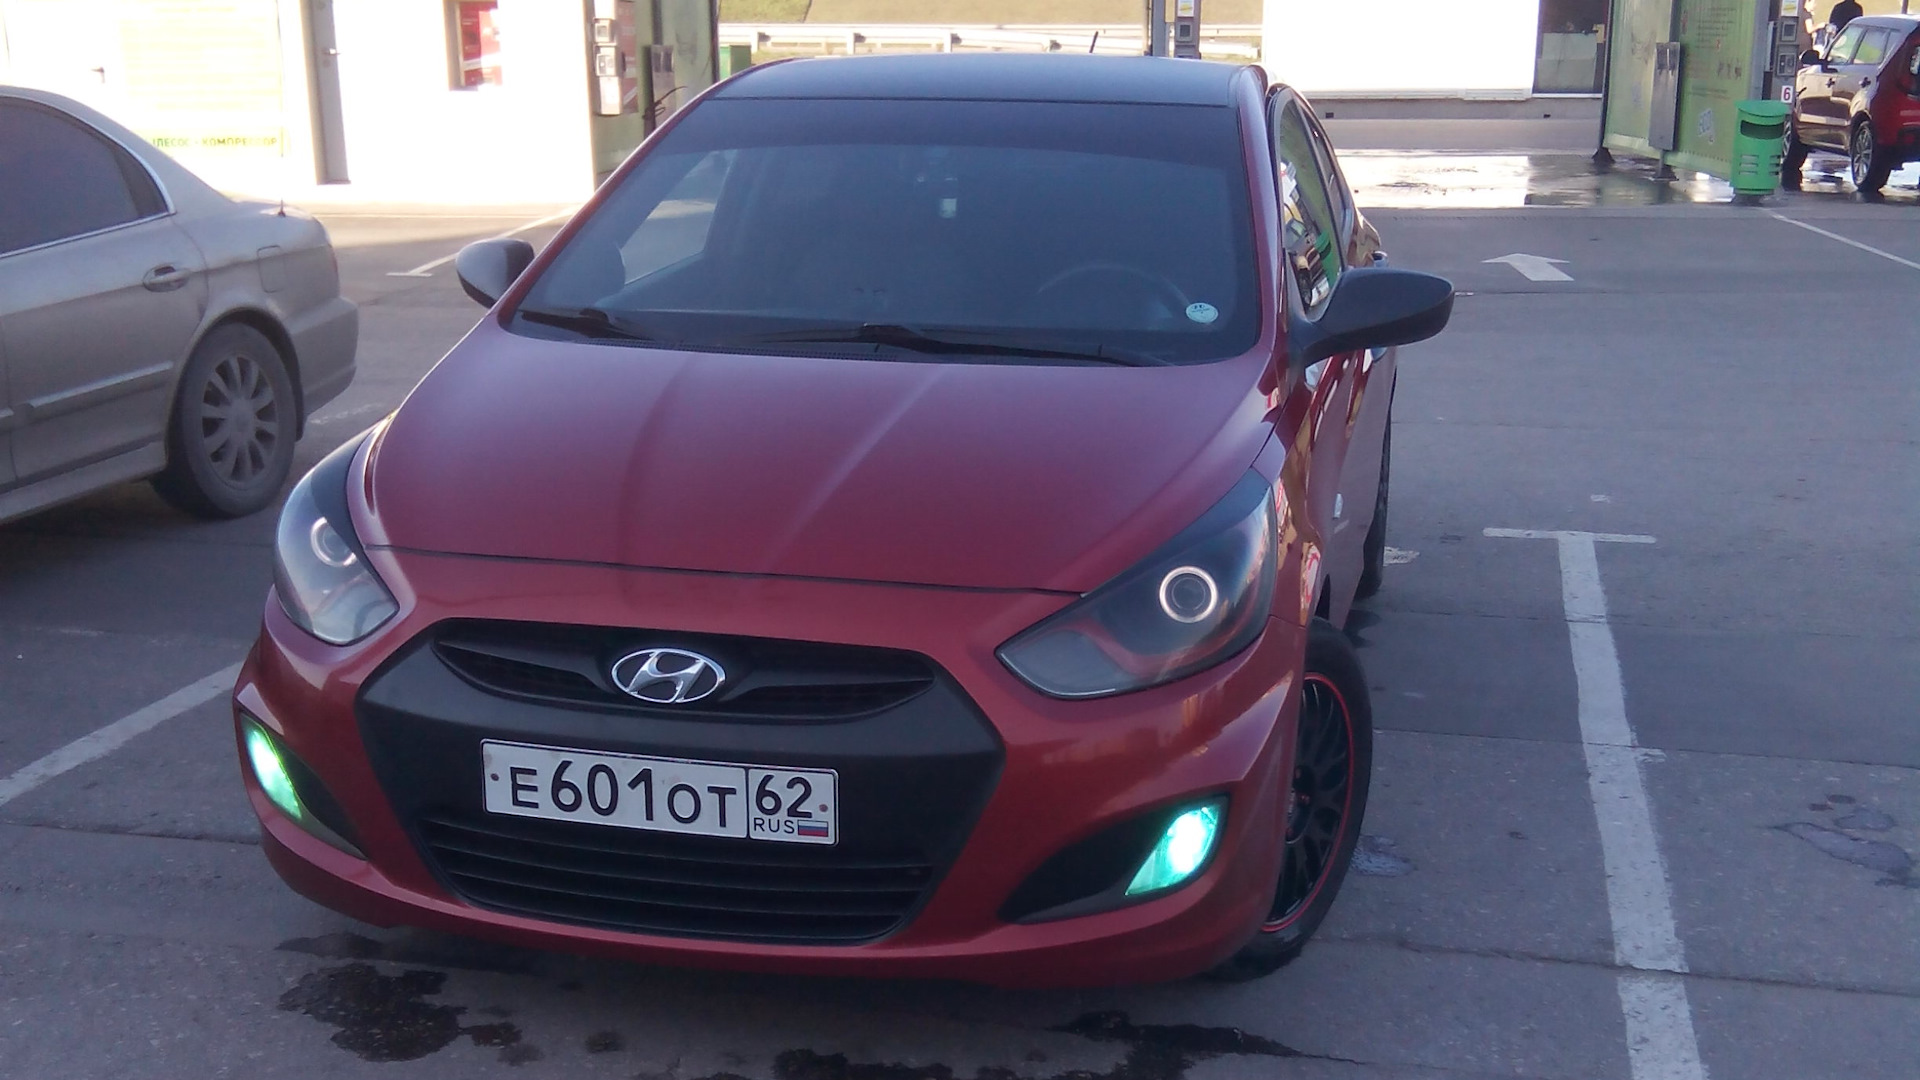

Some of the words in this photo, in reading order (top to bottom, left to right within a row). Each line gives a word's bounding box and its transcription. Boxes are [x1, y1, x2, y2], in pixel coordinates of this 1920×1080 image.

[1783, 87, 1791, 101] 6
[510, 760, 737, 828] Е601ОТ
[755, 774, 813, 818] 62
[753, 817, 795, 834] RUS
